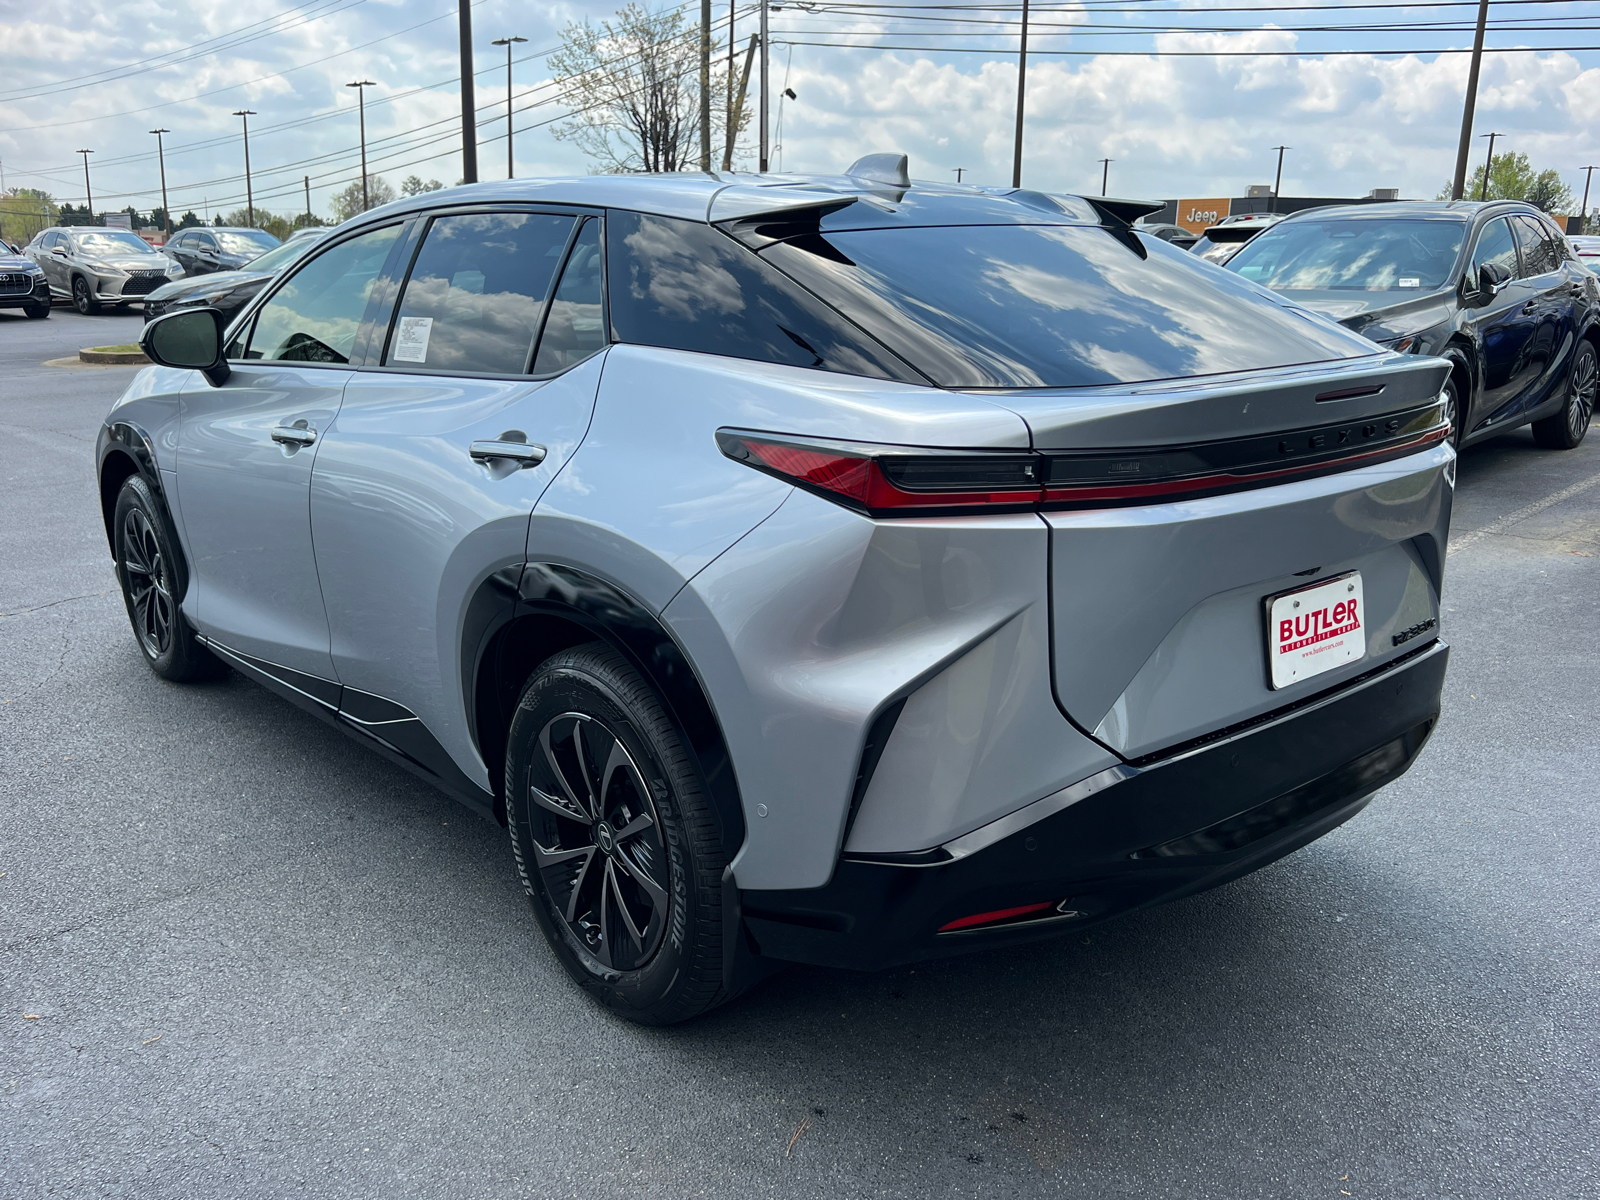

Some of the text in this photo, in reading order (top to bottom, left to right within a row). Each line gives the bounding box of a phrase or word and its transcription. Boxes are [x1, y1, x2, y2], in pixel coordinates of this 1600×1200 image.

[1187, 208, 1218, 225] Jeep
[1278, 420, 1399, 454] LEXUS
[1337, 621, 1359, 634] GROUP
[1302, 640, 1344, 658] www.butlercars.com
[650, 778, 687, 955] BRIDGESTONE
